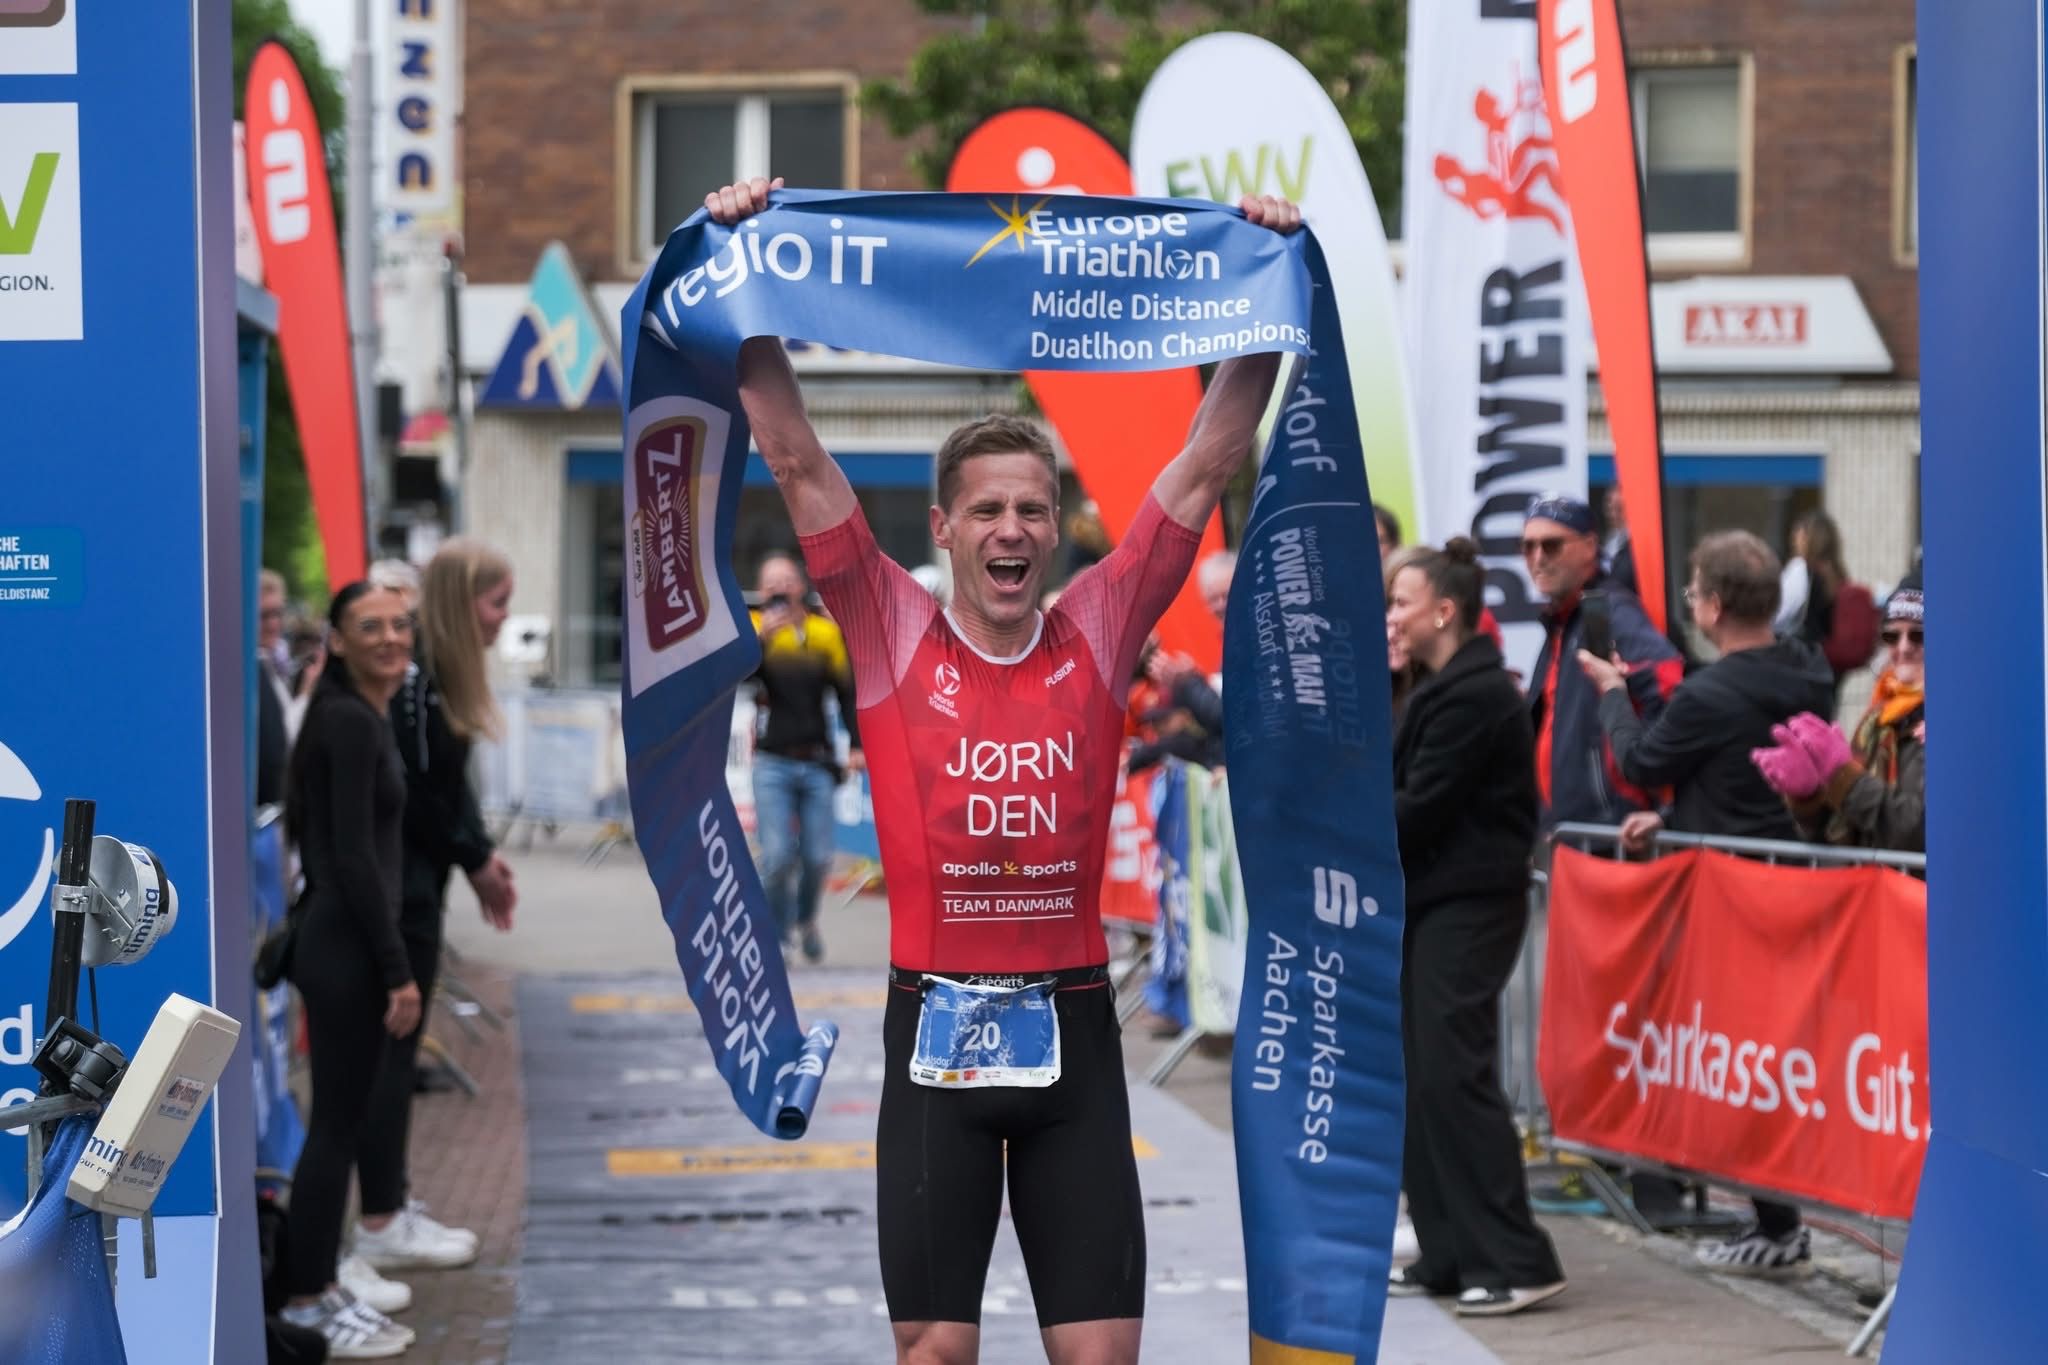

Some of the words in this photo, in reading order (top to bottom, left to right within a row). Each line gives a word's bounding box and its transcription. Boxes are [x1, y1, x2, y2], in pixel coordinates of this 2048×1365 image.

[1030, 211, 1188, 240] Europe
[662, 219, 813, 329] regio
[1032, 239, 1221, 280] Triathlon
[1031, 291, 1123, 320] Middle
[1132, 293, 1251, 321] Distance
[1698, 309, 1800, 341] AKAI
[1161, 320, 1311, 358] Champions
[1471, 260, 1566, 623] POWER
[647, 432, 697, 635] LAMBERTZ
[1303, 525, 1322, 563] World
[1269, 527, 1312, 609] POWER
[1309, 563, 1325, 602] Series
[1254, 591, 1284, 656] Alsdorf
[1044, 658, 1077, 689] FUSION
[1290, 653, 1327, 706] MAN
[946, 731, 1074, 783] JØRN
[967, 793, 1057, 838] DEN
[942, 861, 1001, 877] apollo
[1022, 860, 1077, 879] sports
[943, 898, 990, 914] TEAM
[995, 895, 1075, 914] DANMARK
[700, 799, 778, 1057] Triathlon
[692, 911, 761, 1096] World
[978, 978, 1025, 988] SPORTS
[1252, 931, 1299, 1092] Aachen
[963, 1021, 1001, 1051] 20
[1299, 945, 1346, 1164] Sparkasse
[1604, 1000, 1827, 1120] Sparkasse.
[1846, 1032, 1920, 1141] Gut
